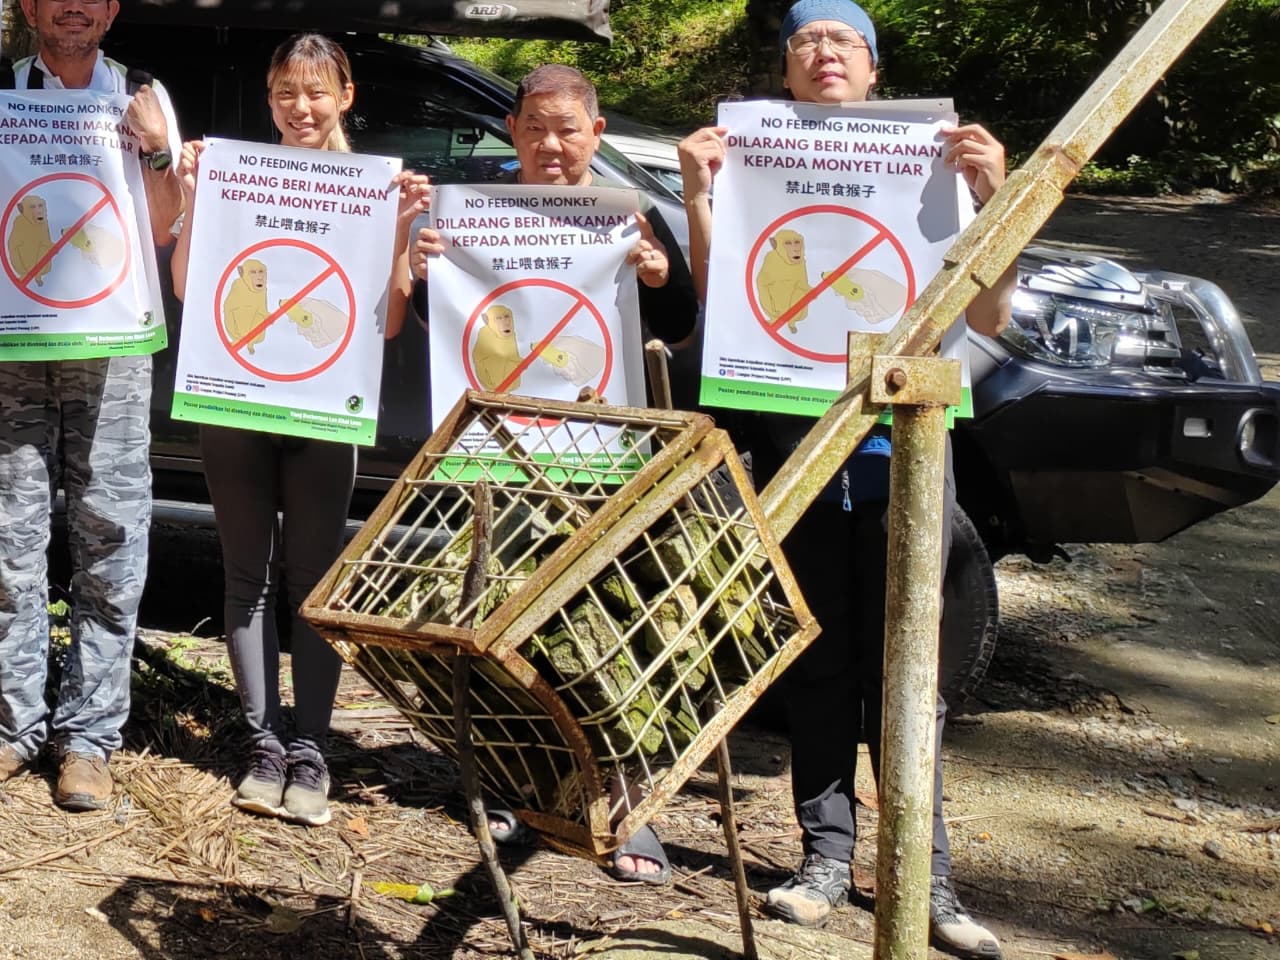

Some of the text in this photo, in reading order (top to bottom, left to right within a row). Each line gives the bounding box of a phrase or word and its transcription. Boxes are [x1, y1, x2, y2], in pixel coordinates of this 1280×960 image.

[470, 6, 498, 16] ARB
[8, 103, 124, 117] NO FEEDING MONKEY
[52, 120, 79, 130] BERI
[761, 118, 910, 135] NO FEEDING MONKEY
[51, 135, 106, 147] MONYET
[110, 138, 133, 153] LIAR
[728, 136, 942, 157] DILARANG BERI MAKANAN
[30, 154, 103, 166] 禁止喂食猴子
[239, 155, 363, 178] NO FEEDING MONKEY
[744, 155, 923, 176] KEPADA MONYET LIAR
[209, 169, 388, 200] DILARANG BERI MAKANAN
[786, 181, 876, 198] 禁止喂食猴子
[221, 189, 371, 216] KEPADA MONYET LIAR
[465, 197, 598, 208] NO FEEDING MONKEY
[256, 215, 331, 235] 禁止喂食猴子
[436, 215, 627, 229] DILARANG BERI MAKANAN
[452, 233, 614, 247] KEPADA MONYET LIAR
[492, 257, 572, 270] 禁止喂食猴子
